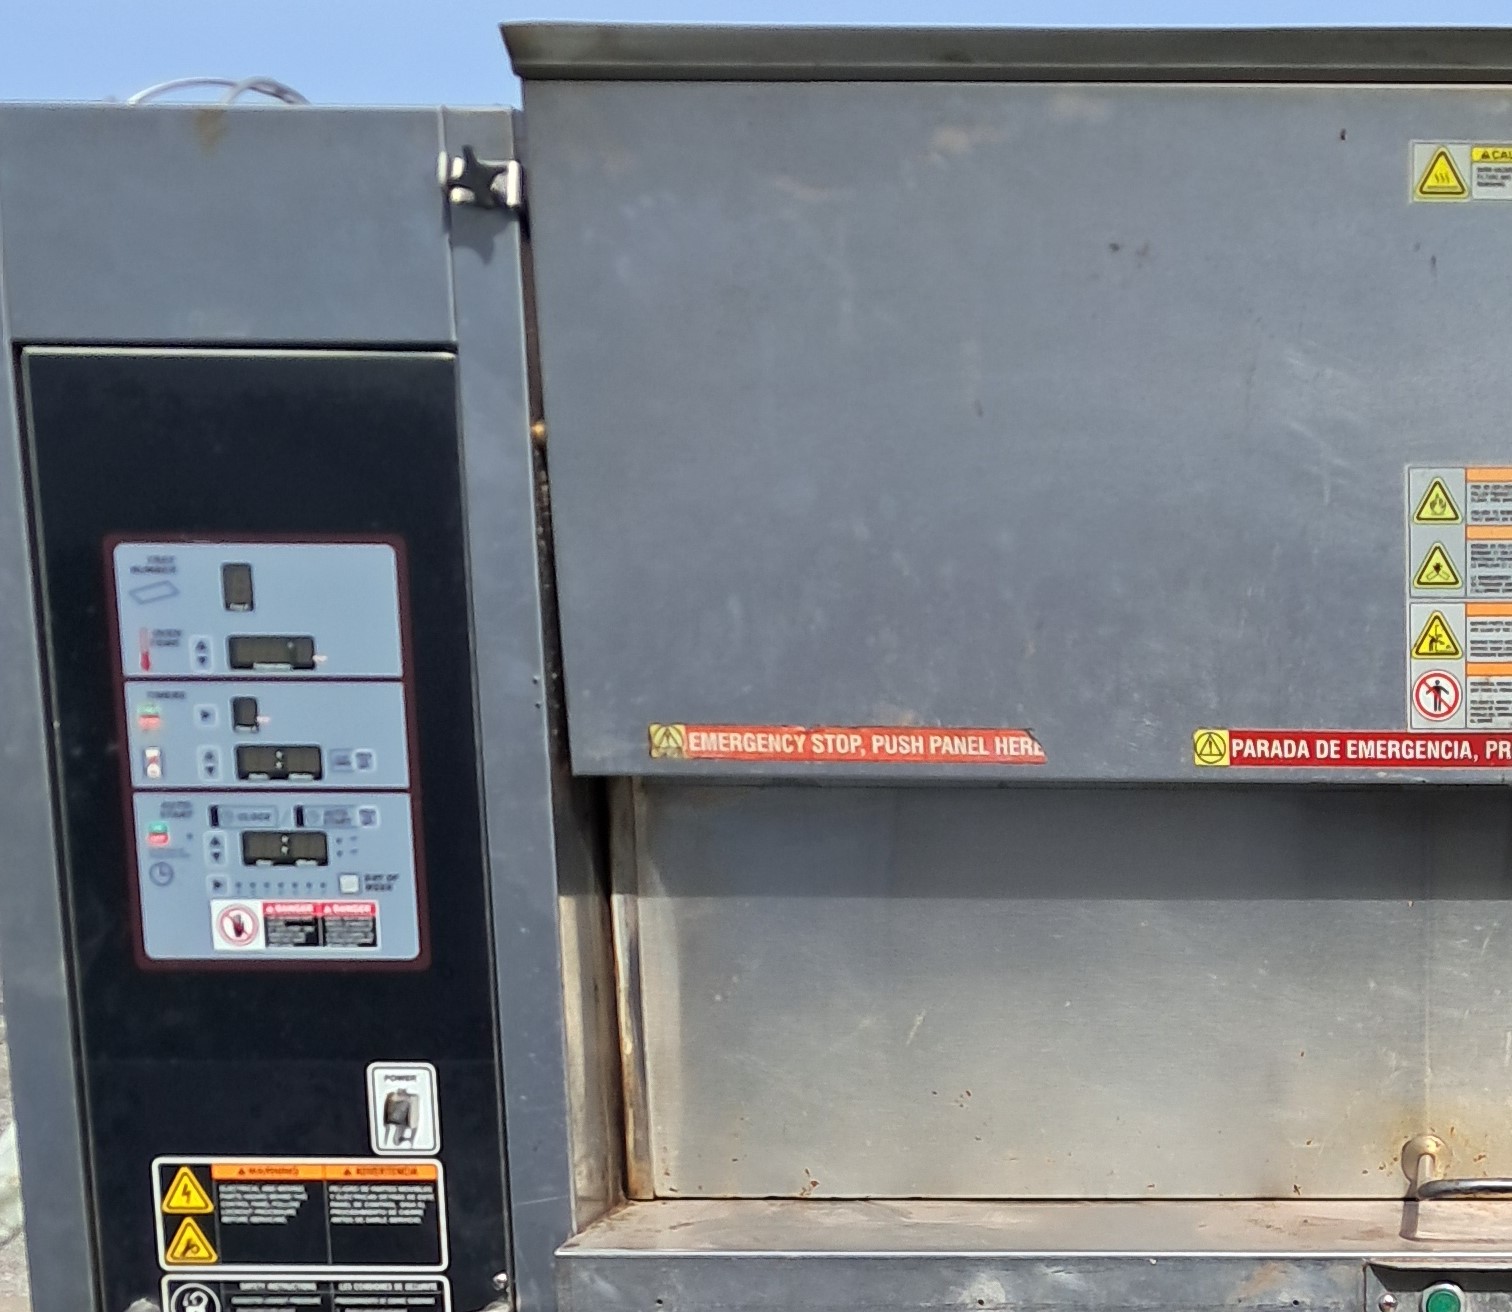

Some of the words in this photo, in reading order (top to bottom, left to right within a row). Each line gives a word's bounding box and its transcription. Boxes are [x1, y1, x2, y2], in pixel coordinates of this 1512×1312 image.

[688, 732, 806, 754] EMERGENCY
[810, 735, 866, 757] STOP,
[872, 735, 924, 755] PUSH
[930, 736, 990, 755] PANEL
[1231, 738, 1310, 759] PARADA
[1316, 739, 1343, 759] DE
[1346, 739, 1479, 763] EMERGENCIA,
